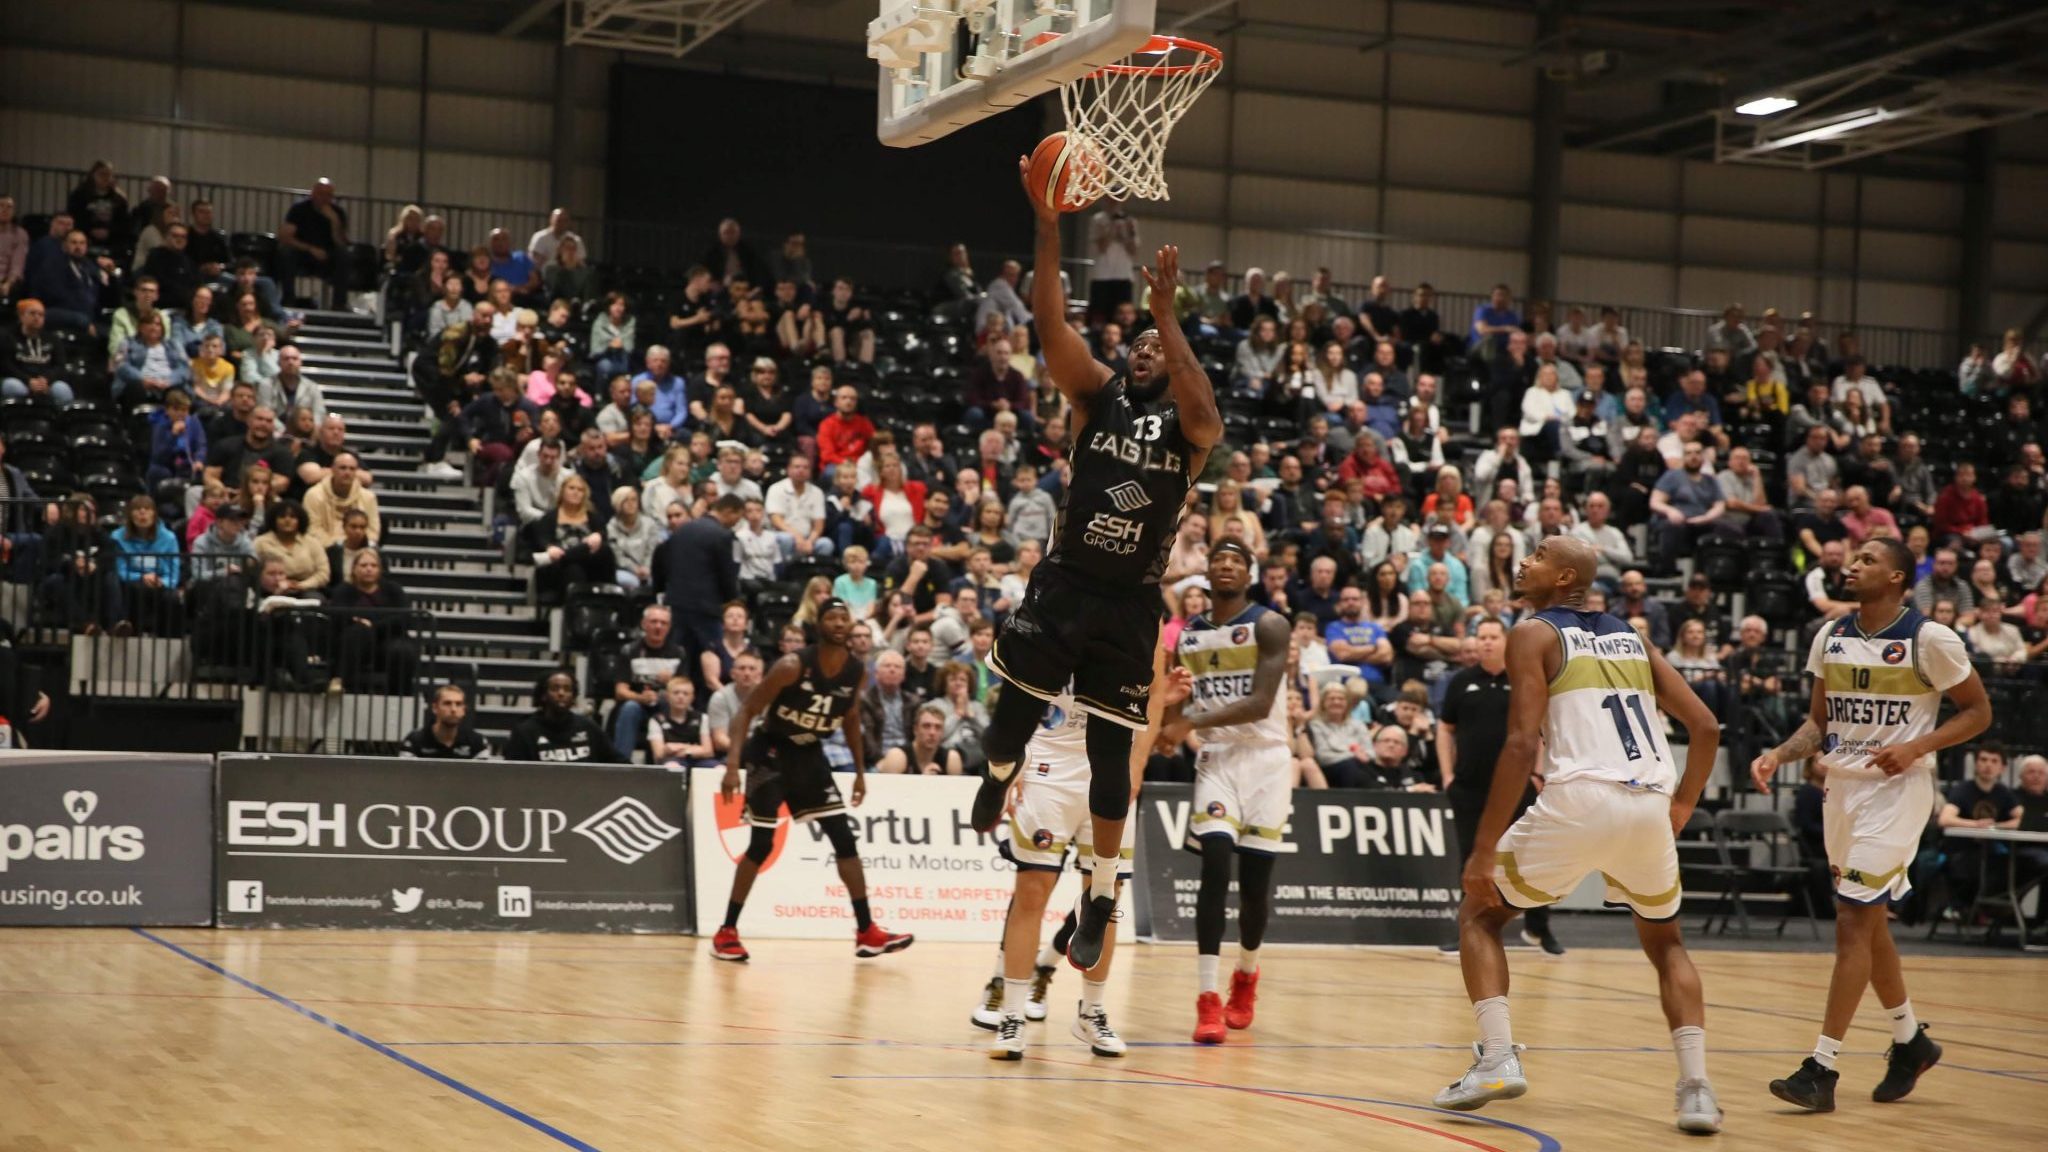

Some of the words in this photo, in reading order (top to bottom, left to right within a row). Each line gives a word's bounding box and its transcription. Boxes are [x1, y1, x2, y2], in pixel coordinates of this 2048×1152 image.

[1133, 415, 1162, 441] 13
[1087, 512, 1144, 542] ESH
[1083, 532, 1137, 555] GROUP
[1209, 652, 1220, 669] 4
[1193, 674, 1253, 699] RCESTE
[1851, 667, 1870, 689] 10
[807, 694, 833, 714] 21
[1826, 697, 1912, 726] ORCESTER
[777, 705, 844, 732] EAGLE
[1601, 693, 1661, 762] 11
[227, 800, 346, 848] ESH
[358, 803, 567, 853] GROUP
[1317, 804, 1454, 857] PRIN
[909, 854, 984, 872] Motors
[825, 885, 924, 900] NEASTLE
[1274, 885, 1306, 900] JOIN
[1307, 885, 1335, 900] THE
[1336, 886, 1419, 902] REVOLUTION
[1422, 888, 1450, 902] AND
[774, 905, 884, 919] SUNDERLD
[899, 907, 966, 920] DURHAM
